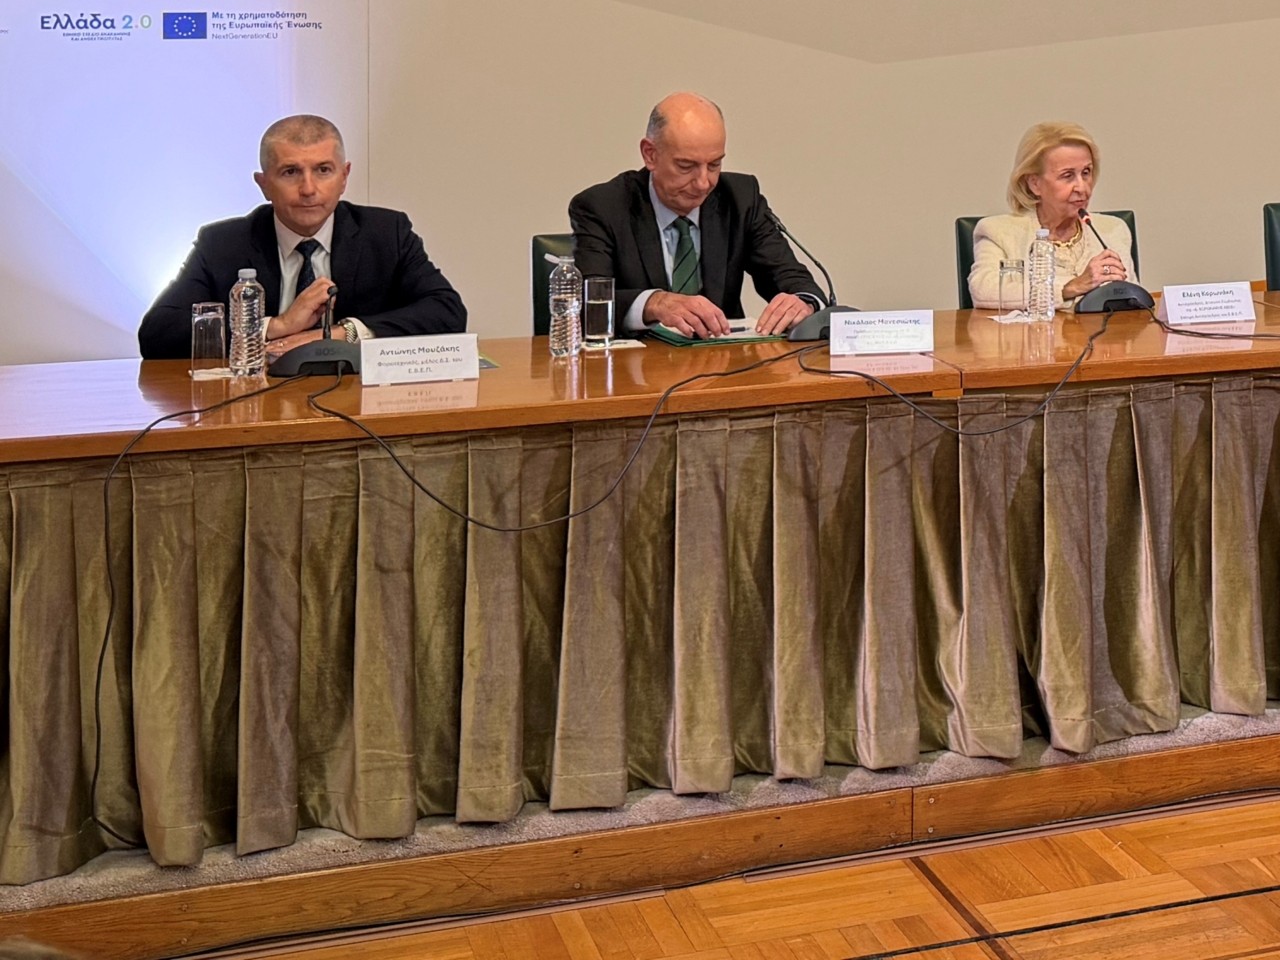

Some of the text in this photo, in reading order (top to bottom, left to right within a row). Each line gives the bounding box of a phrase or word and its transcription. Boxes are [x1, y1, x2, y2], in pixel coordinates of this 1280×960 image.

[238, 11, 307, 20] χρηματοδότηση
[41, 13, 152, 29] Ελλάδα 2.0
[229, 21, 282, 29] Ευρωπαϊκής
[286, 21, 322, 29] Ένωσης
[380, 348, 416, 356] Αντώνης
